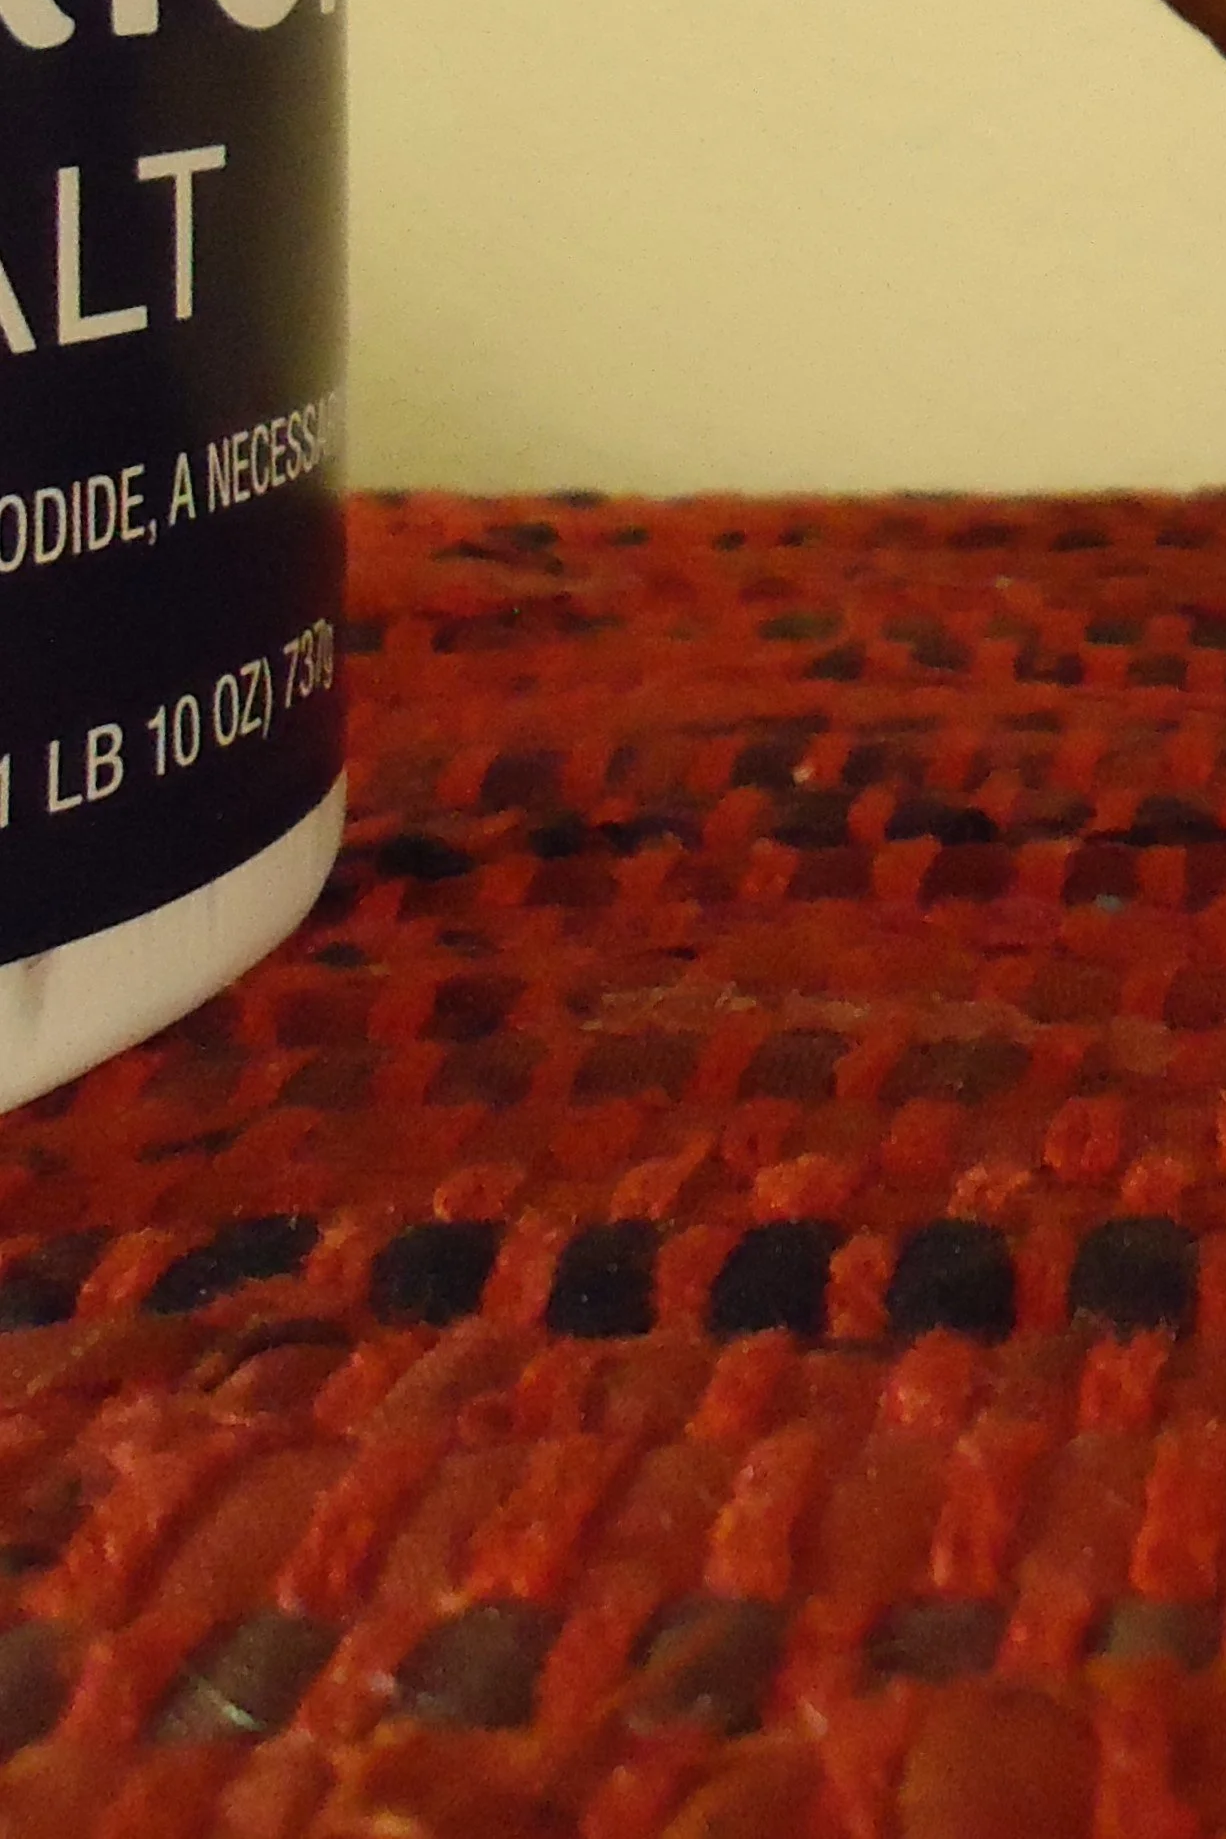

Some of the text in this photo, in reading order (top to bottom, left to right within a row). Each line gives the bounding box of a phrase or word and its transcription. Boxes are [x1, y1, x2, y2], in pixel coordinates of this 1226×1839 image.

[167, 452, 196, 526] A
[48, 723, 124, 814] LB
[147, 693, 200, 776] 10
[212, 656, 273, 747] OZ)
